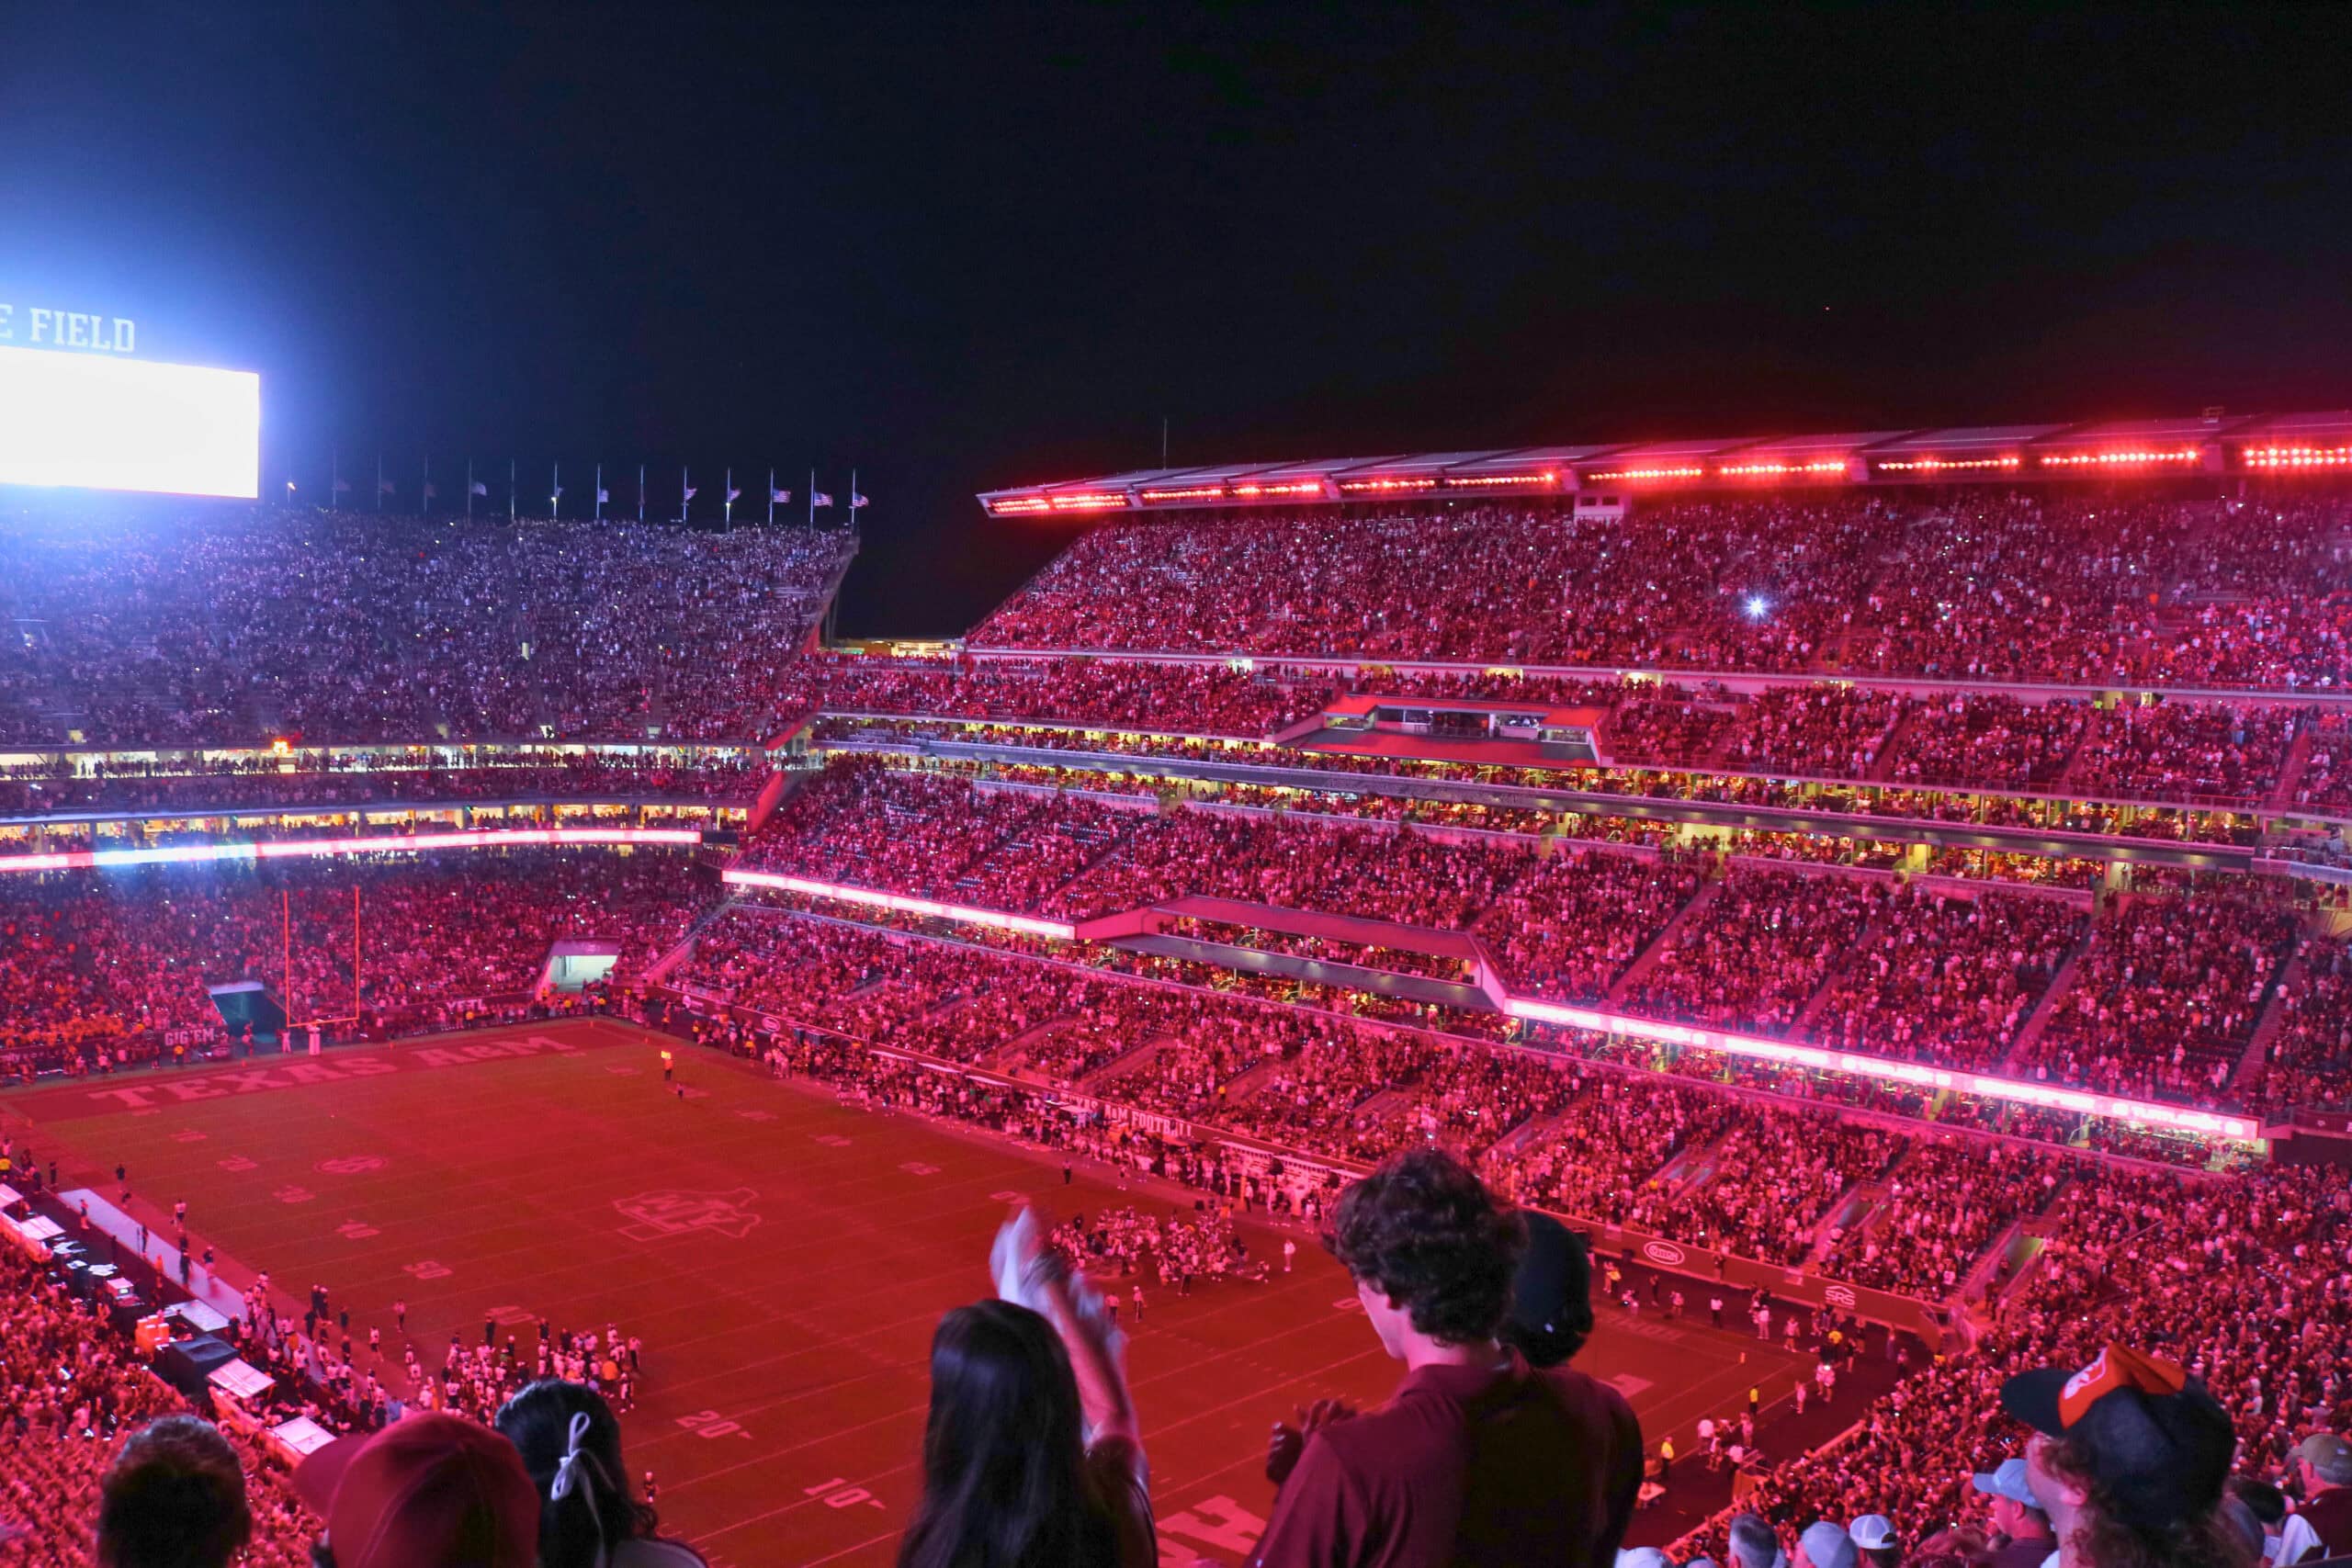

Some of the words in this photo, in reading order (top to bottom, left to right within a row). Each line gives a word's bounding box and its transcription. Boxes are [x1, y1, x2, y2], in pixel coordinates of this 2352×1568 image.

[29, 308, 135, 352] FIELD
[88, 1057, 398, 1108] TEXAS
[413, 1036, 577, 1066] A&M
[402, 1260, 454, 1280] 50
[1825, 1289, 1855, 1306] SRS
[676, 1410, 741, 1438] 20
[803, 1477, 871, 1508] 10
